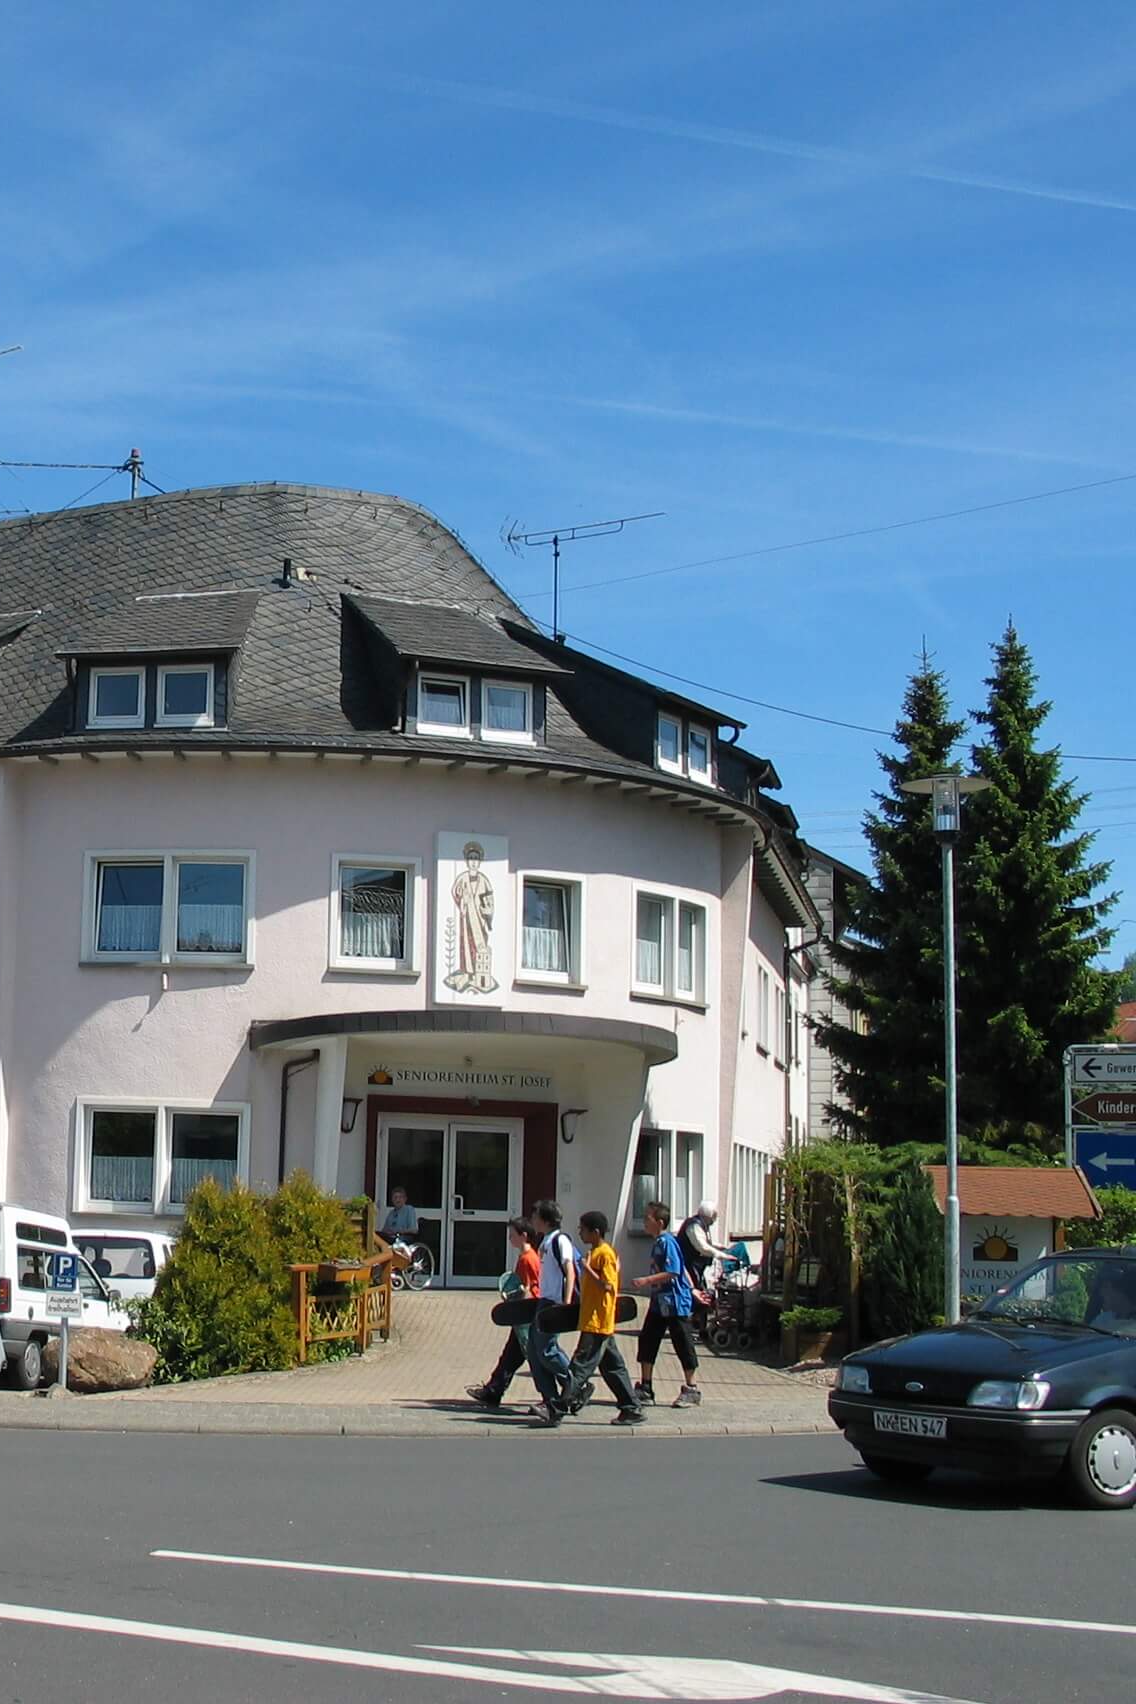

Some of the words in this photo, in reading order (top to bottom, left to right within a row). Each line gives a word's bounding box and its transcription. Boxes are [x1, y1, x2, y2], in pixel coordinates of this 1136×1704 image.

[396, 1070, 498, 1085] SENIORENHEIM
[59, 1256, 73, 1275] P
[921, 1419, 943, 1435] 547
